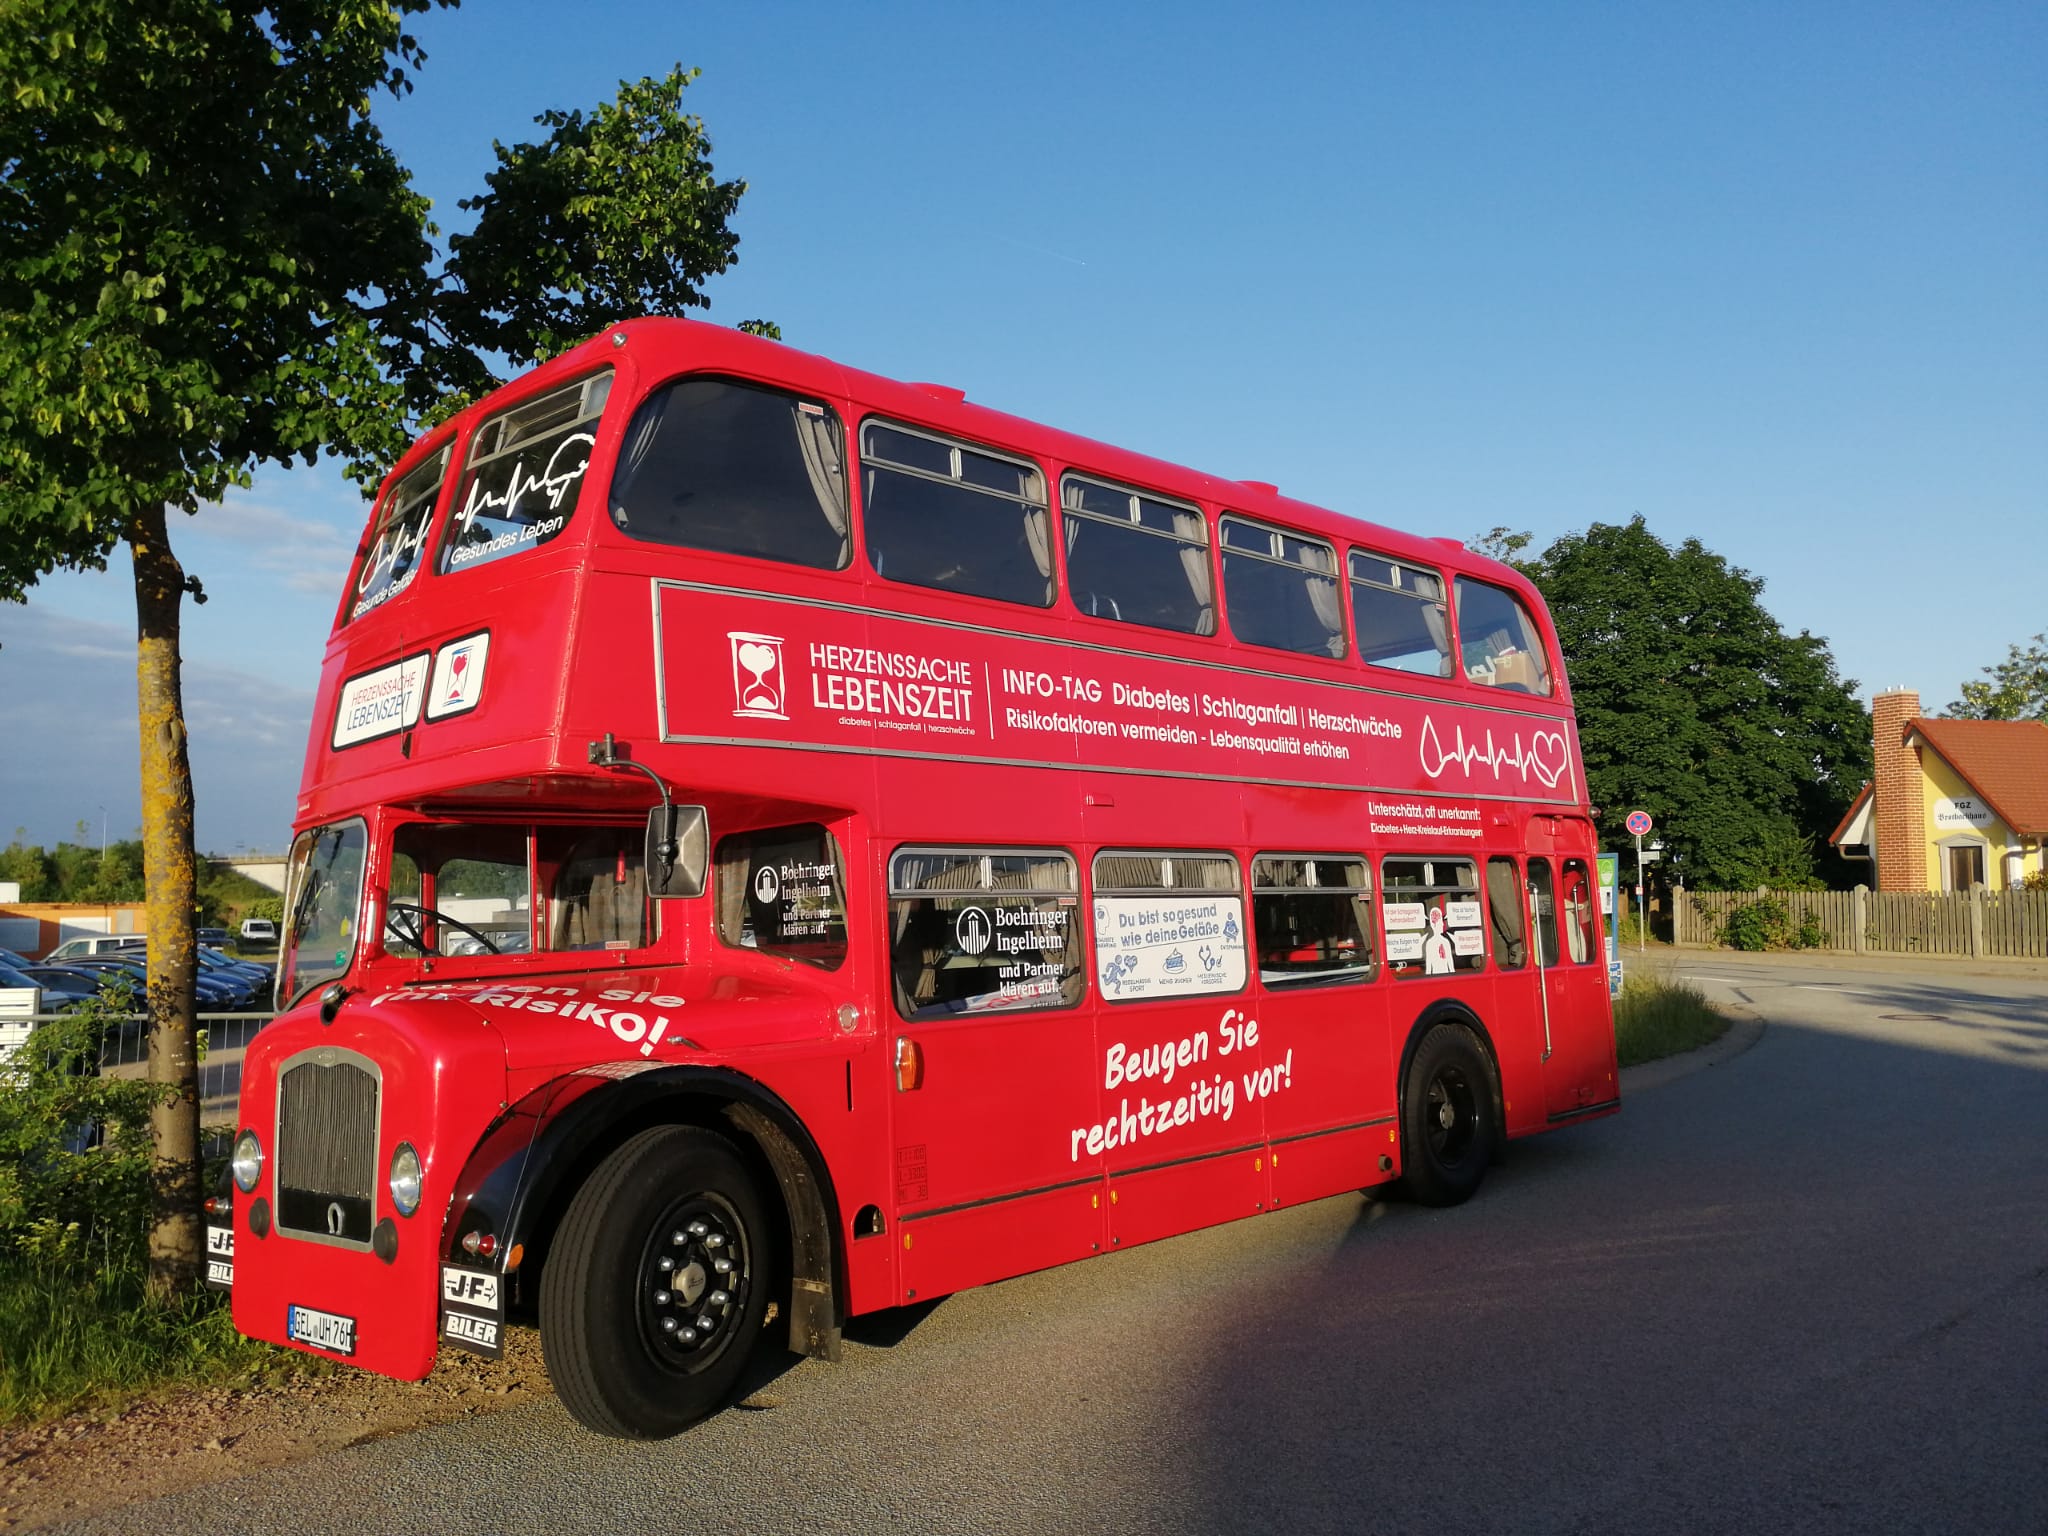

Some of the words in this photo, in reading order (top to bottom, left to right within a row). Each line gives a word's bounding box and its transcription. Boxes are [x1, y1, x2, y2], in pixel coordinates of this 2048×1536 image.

[450, 531, 518, 565] Gesundes
[519, 515, 564, 543] Leben
[809, 642, 972, 686] HERZENSSACHE
[351, 671, 417, 707] HERZENSSACHE
[811, 673, 973, 722] LEBENSZEIT
[346, 690, 413, 731] LEBENSZEIT
[1001, 668, 1103, 703] INFO-TAG
[1112, 682, 1191, 714] Diabetes
[1203, 695, 1298, 727] Schlaganfall
[1308, 707, 1403, 739] Herzschwäche
[838, 716, 872, 727] diabetes
[878, 719, 921, 732] schlaganfall
[928, 723, 976, 736] herzschwäche
[1006, 707, 1118, 738] Risikofaktoren
[1121, 724, 1198, 746] vermeiden
[1209, 728, 1301, 756] Lebensqualität
[1303, 740, 1350, 760] erhöhen
[1368, 801, 1424, 819] Unterschätzt,
[1424, 805, 1436, 818] oft
[1437, 807, 1482, 820] unerkannt:
[1954, 801, 1972, 809] FGZ
[780, 861, 836, 881] Boehringer
[781, 881, 831, 903] Ingelheim
[782, 908, 799, 921] und
[800, 907, 831, 920] Partner
[994, 906, 1068, 929] Boehringer
[1118, 913, 1136, 928] Du
[1138, 909, 1160, 926] bist
[1162, 909, 1176, 923] so
[1176, 903, 1217, 924] gesund
[783, 922, 809, 936] klären
[810, 920, 827, 934] auf.
[1120, 931, 1142, 947] wie
[1145, 928, 1178, 944] deine
[1178, 921, 1220, 938] Gefäße
[995, 930, 1063, 954] Ingelheim
[999, 961, 1021, 978] und
[1023, 961, 1064, 977] Partner
[597, 987, 686, 1008] Sie
[999, 980, 1036, 997] klären
[468, 992, 670, 1057] Risiko!
[1105, 1030, 1209, 1090] Beugen
[1218, 1008, 1259, 1056] Sie
[1071, 1073, 1235, 1162] rechtzeitig
[1243, 1048, 1293, 1103] vor!
[294, 1311, 312, 1337] GEL
[446, 1315, 497, 1343] BILER
